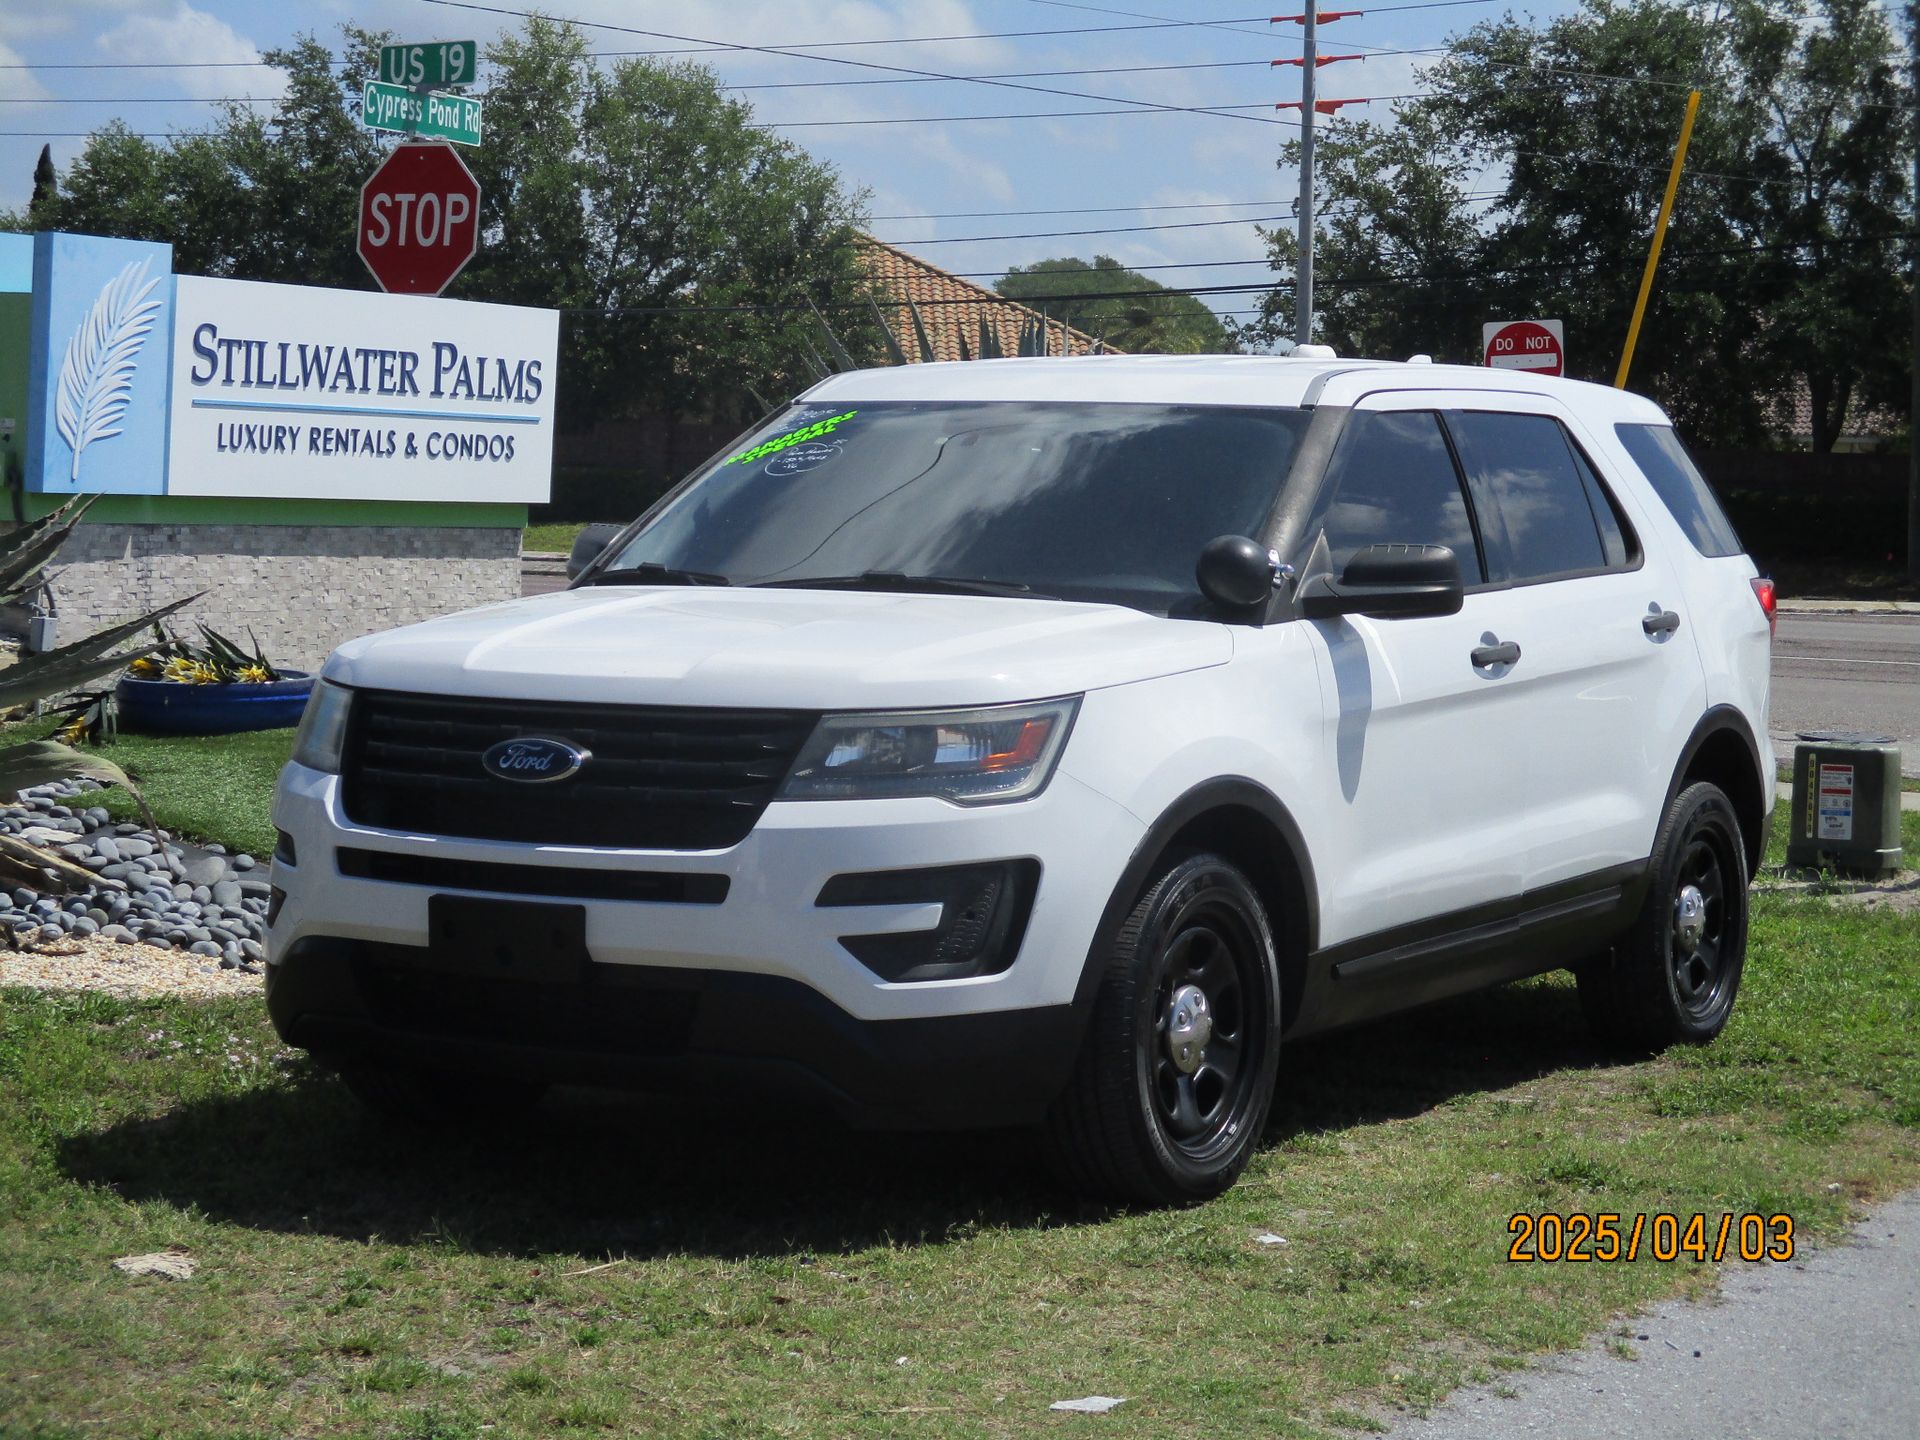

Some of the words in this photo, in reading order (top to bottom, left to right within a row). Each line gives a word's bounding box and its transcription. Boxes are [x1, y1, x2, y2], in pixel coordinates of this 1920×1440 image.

[390, 47, 425, 83] US
[440, 44, 465, 82] 19
[366, 85, 422, 124] Cypress
[428, 96, 459, 129] Pond
[464, 103, 480, 133] Rd
[367, 192, 470, 247] STOP
[191, 322, 421, 397] STILLWATER
[429, 341, 544, 403] PALMS
[1495, 338, 1514, 351] DO
[1525, 336, 1551, 350] NOT
[217, 422, 301, 454] LUXURY
[308, 426, 397, 458] RENTALS
[404, 431, 420, 458] &
[426, 431, 516, 462] CONDOS
[722, 409, 859, 466] MANAGERS
[741, 424, 837, 465] SPECIAL
[499, 743, 555, 771] Ford
